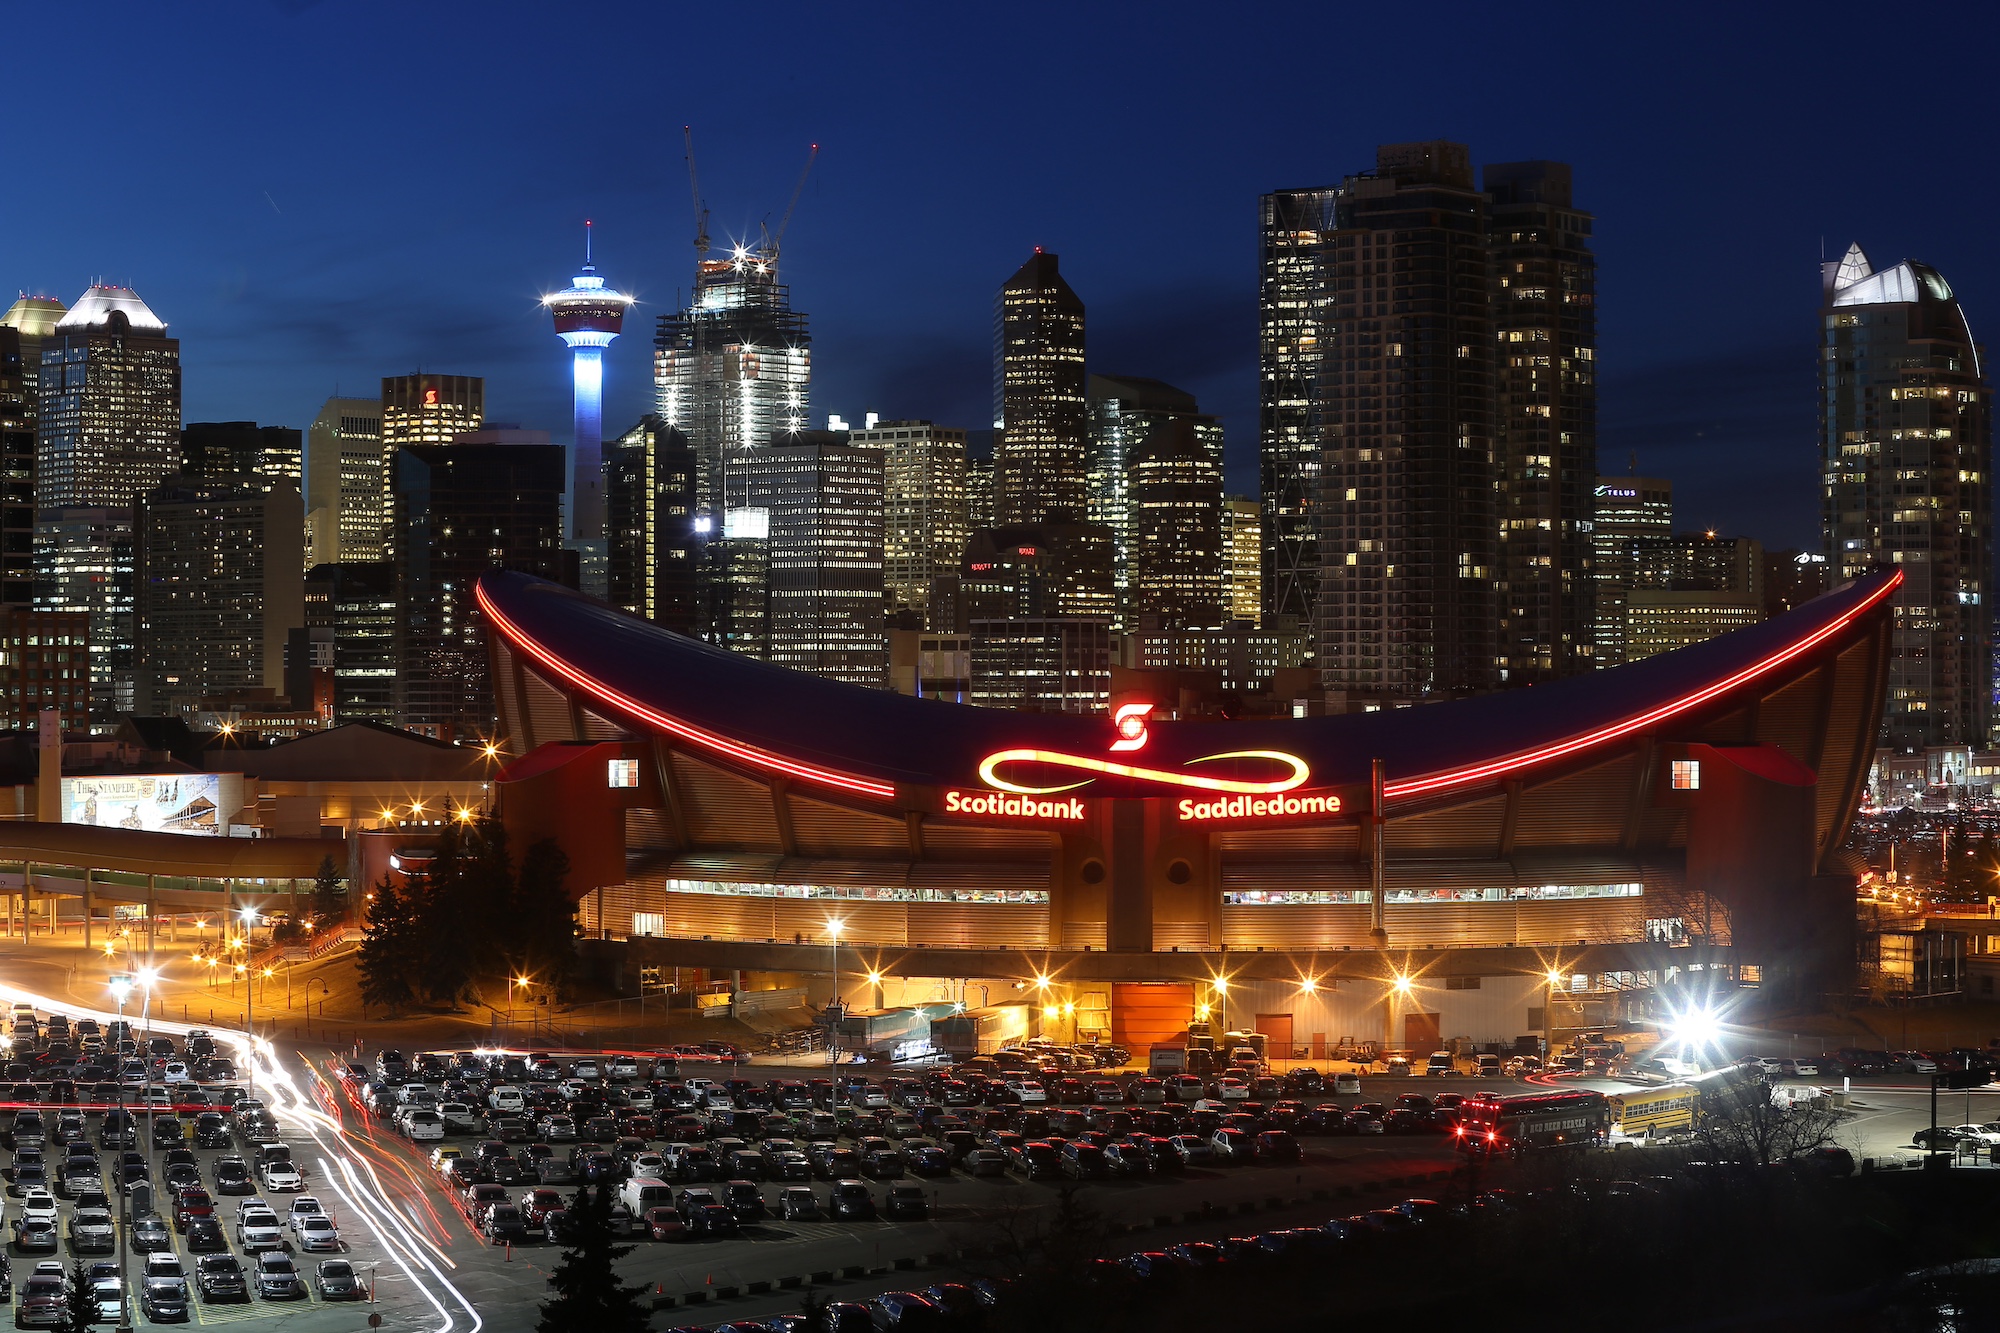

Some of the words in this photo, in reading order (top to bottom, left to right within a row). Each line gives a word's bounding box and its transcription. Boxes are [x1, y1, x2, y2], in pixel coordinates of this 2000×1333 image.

[1607, 489, 1636, 497] TELUS
[970, 563, 992, 571] HYATT
[98, 780, 136, 794] STAMPEDE
[945, 791, 1085, 820] Scotiabank
[1178, 792, 1341, 821] Saddledome
[1530, 1123, 1543, 1134] RED
[1543, 1120, 1561, 1132] DEER
[1562, 1118, 1587, 1130] REBELS
